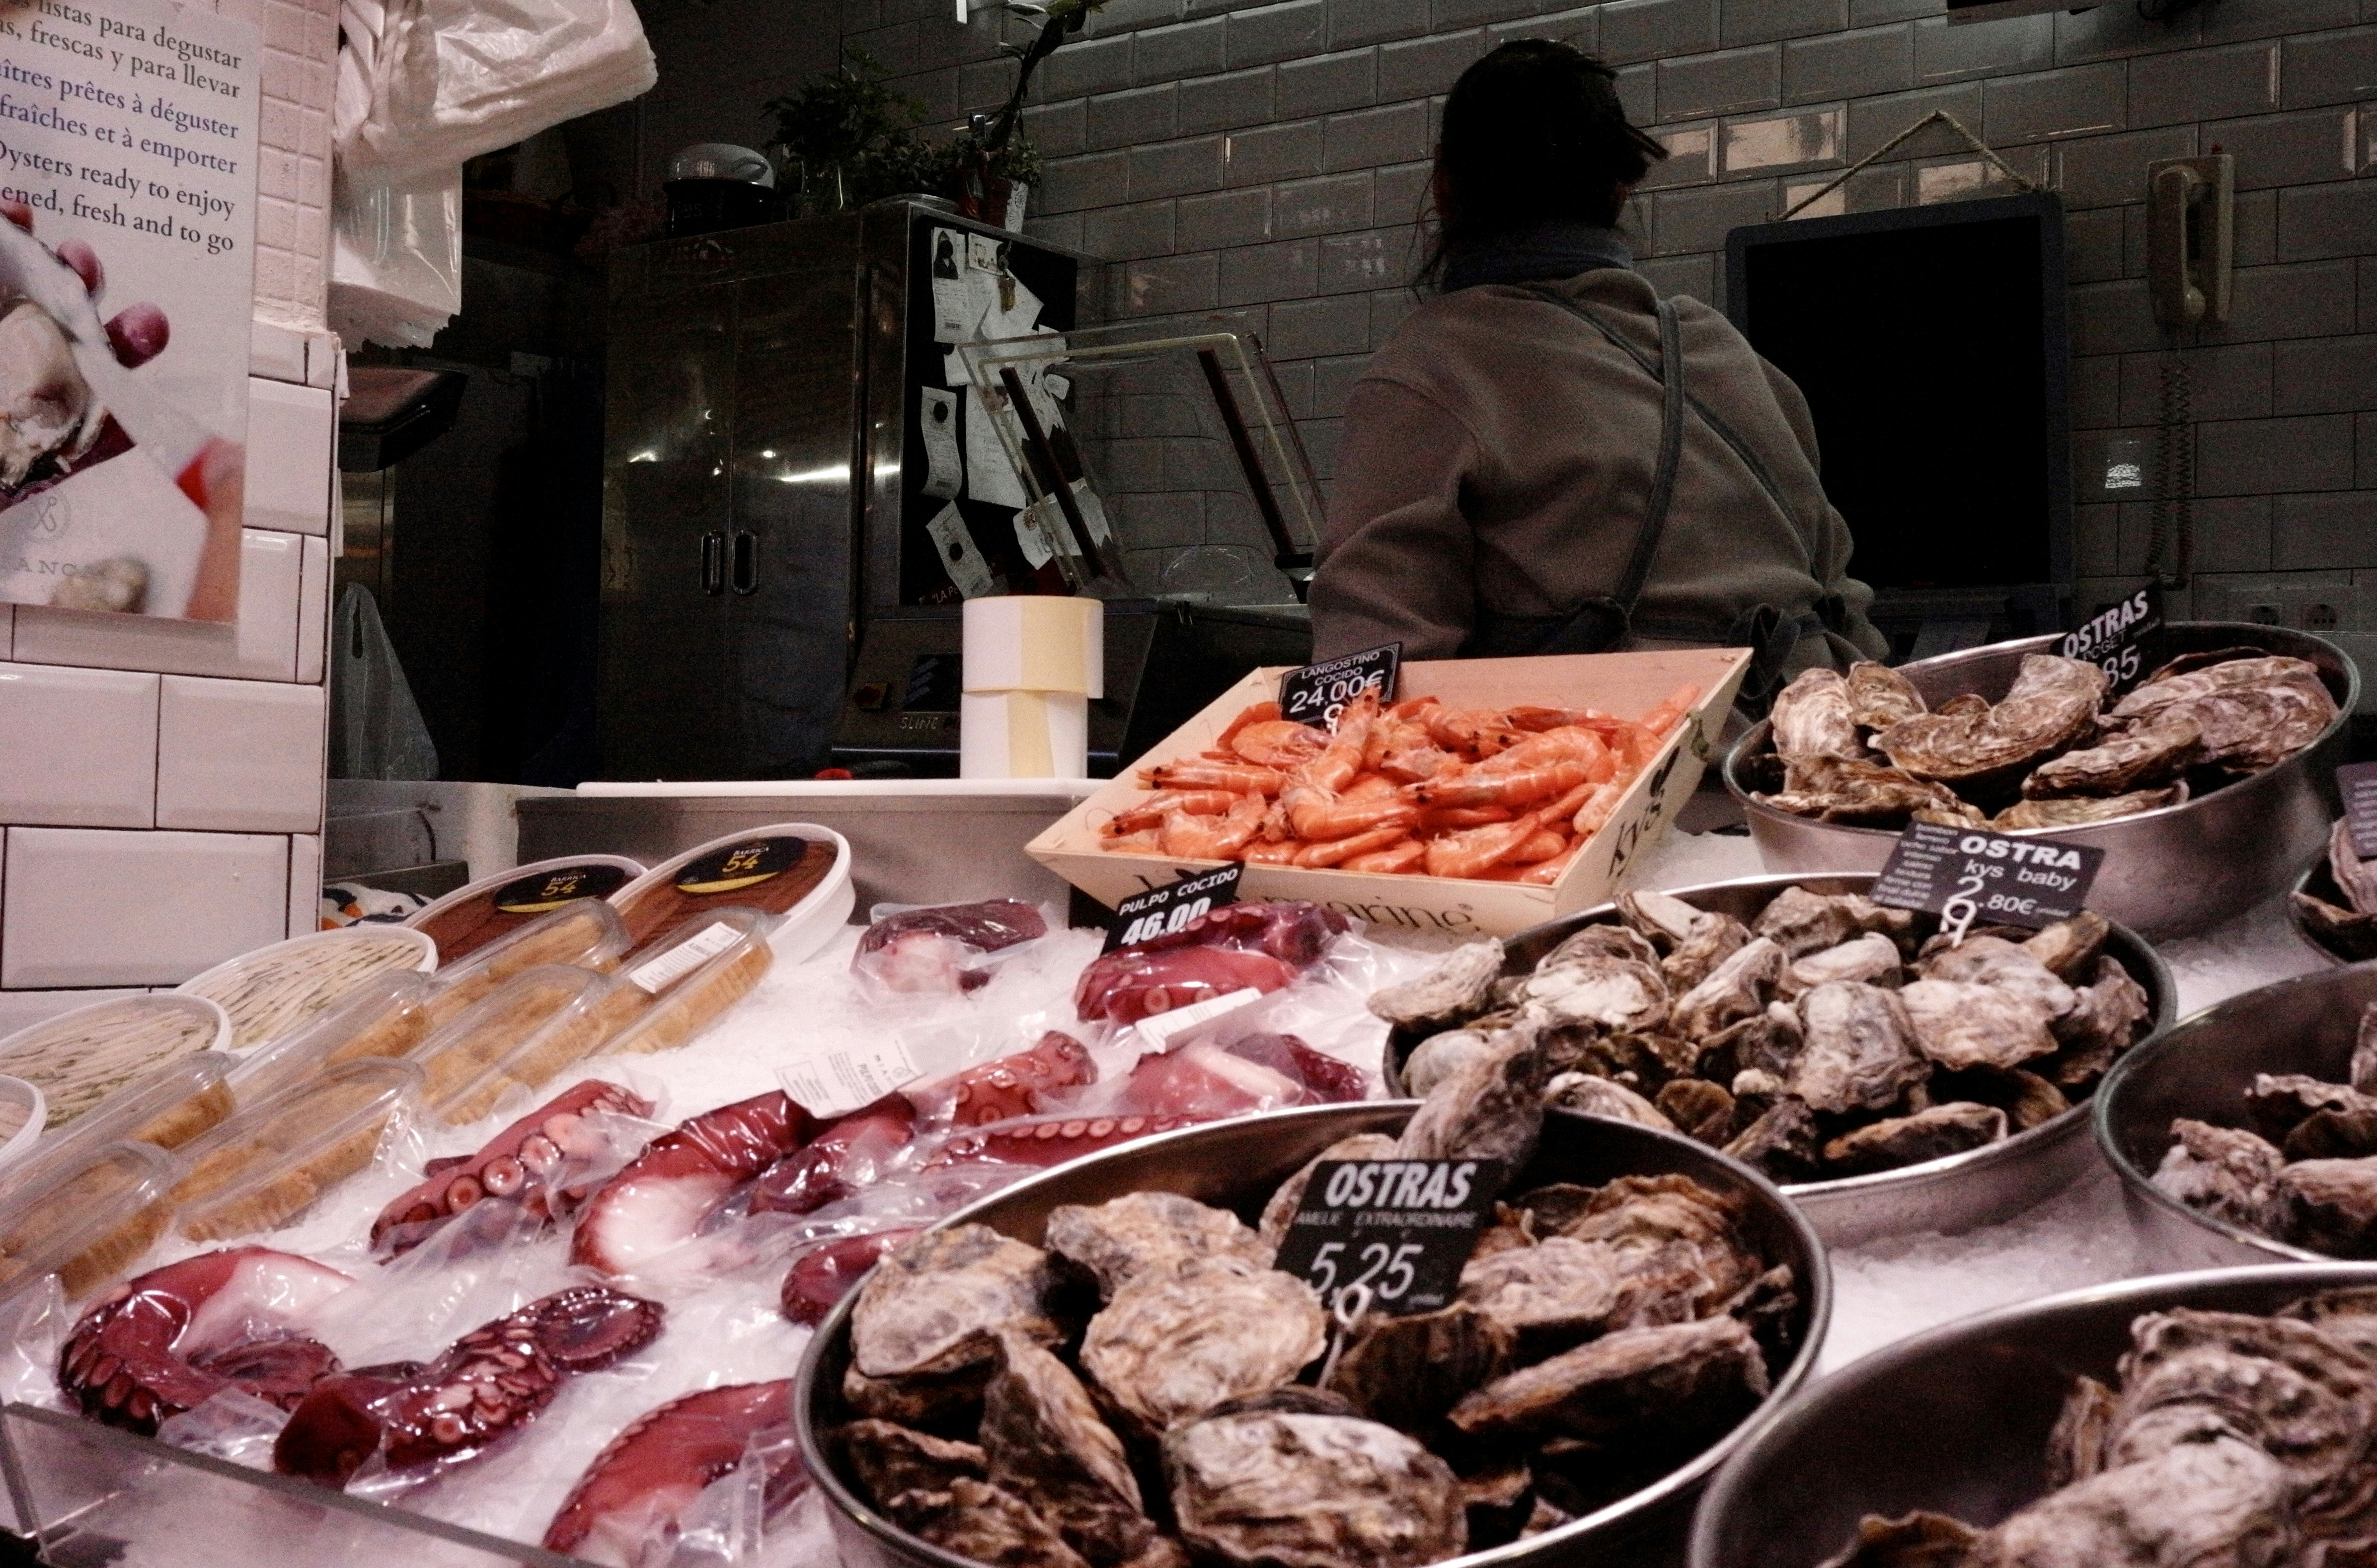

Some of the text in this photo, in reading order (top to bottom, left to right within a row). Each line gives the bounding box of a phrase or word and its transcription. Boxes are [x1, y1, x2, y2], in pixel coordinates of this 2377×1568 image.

[30, 20, 103, 60] frescas
[110, 50, 123, 71] y
[131, 56, 175, 81] para
[183, 64, 240, 98] llevar
[99, 17, 146, 42] para
[153, 26, 242, 70] degustar
[0, 59, 239, 139] îtres prêtes à déguster
[0, 94, 237, 174] fraîches et à emporter
[80, 165, 142, 198] ready
[149, 181, 169, 199] to
[176, 187, 236, 221] enjoy
[72, 194, 126, 227] fresh
[133, 216, 173, 237] and
[180, 225, 201, 243] to
[207, 233, 233, 254] go
[2063, 590, 2148, 659] OSTRAS
[1301, 651, 1380, 679] LANGOSTINO
[1314, 667, 1363, 686] COCIDO
[722, 852, 762, 873] 54
[1959, 835, 2081, 870] OSTRA
[1964, 859, 2078, 892] kys baby
[541, 879, 578, 896] 54
[1119, 868, 1238, 916] PULPO COCIDO
[1121, 896, 1212, 946] 46.00
[1325, 1162, 1478, 1208] OSTRAS
